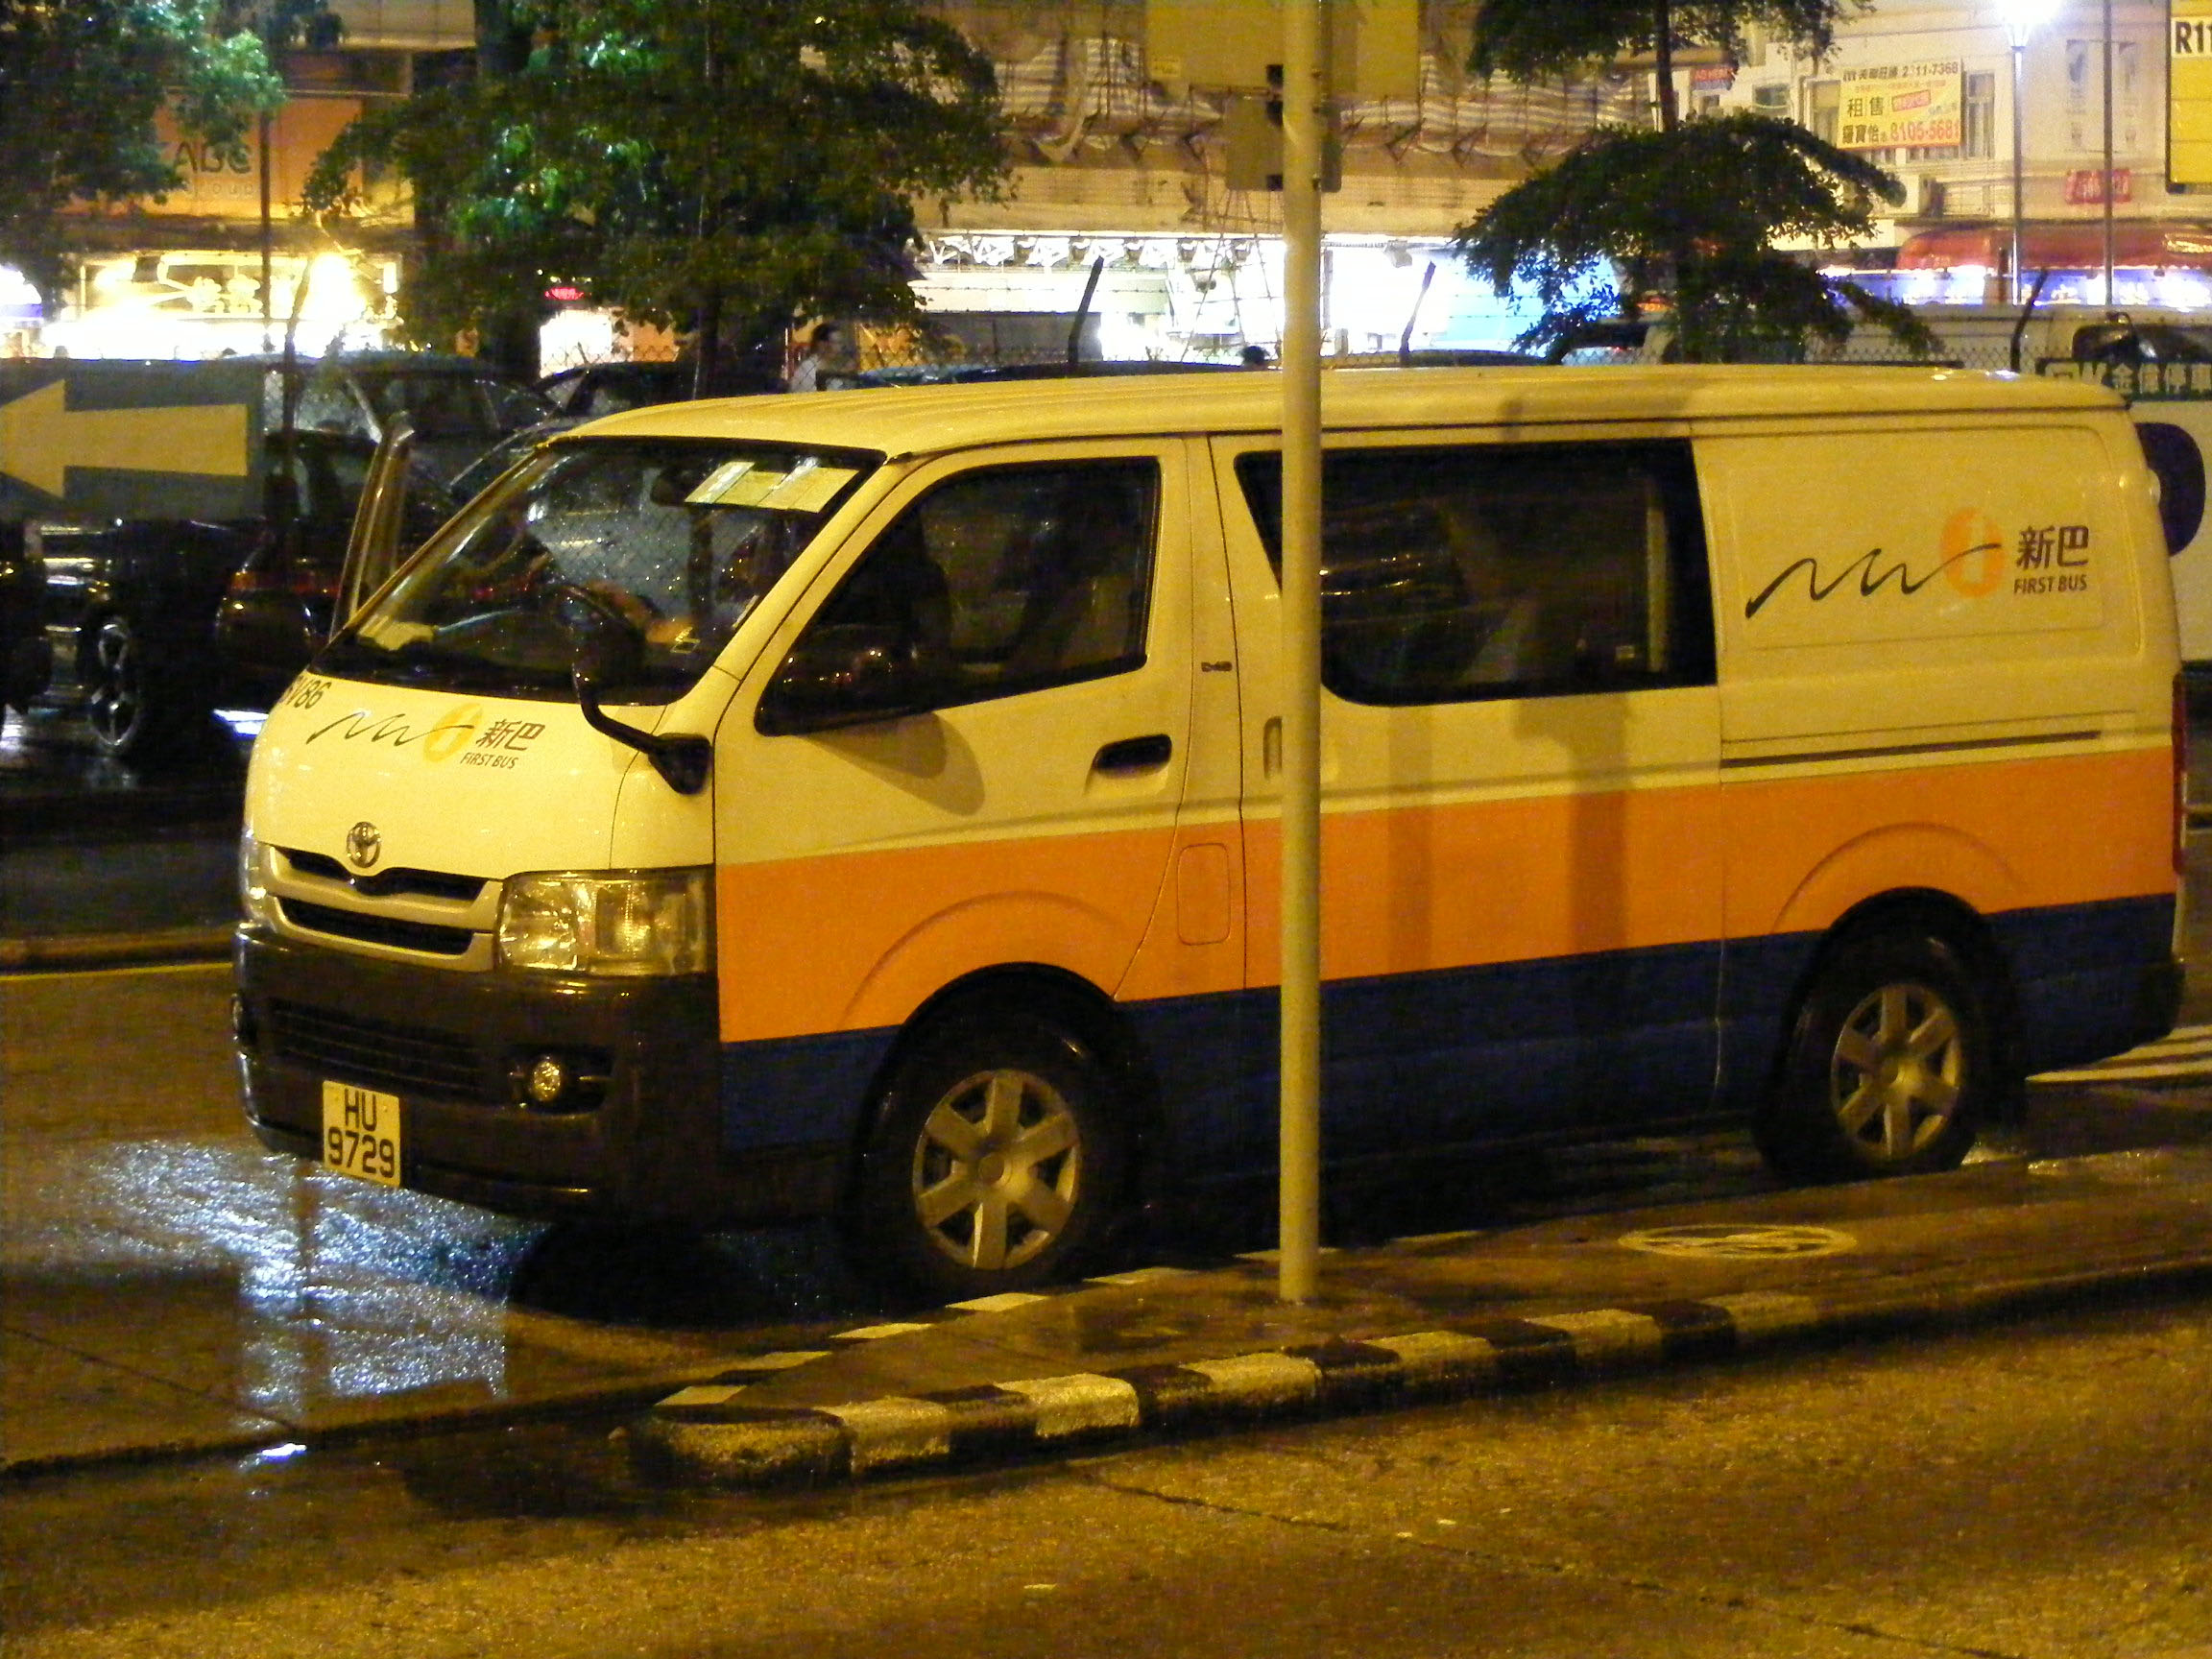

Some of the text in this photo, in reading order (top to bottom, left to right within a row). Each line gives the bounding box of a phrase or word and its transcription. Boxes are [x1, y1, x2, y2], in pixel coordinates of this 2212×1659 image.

[2016, 525, 2089, 570] 新巴
[2013, 574, 2087, 593] FIRST BUS
[475, 718, 545, 751] 新巴
[492, 755, 519, 769] BUS
[345, 1088, 376, 1131] HU
[328, 1126, 395, 1178] 9729
